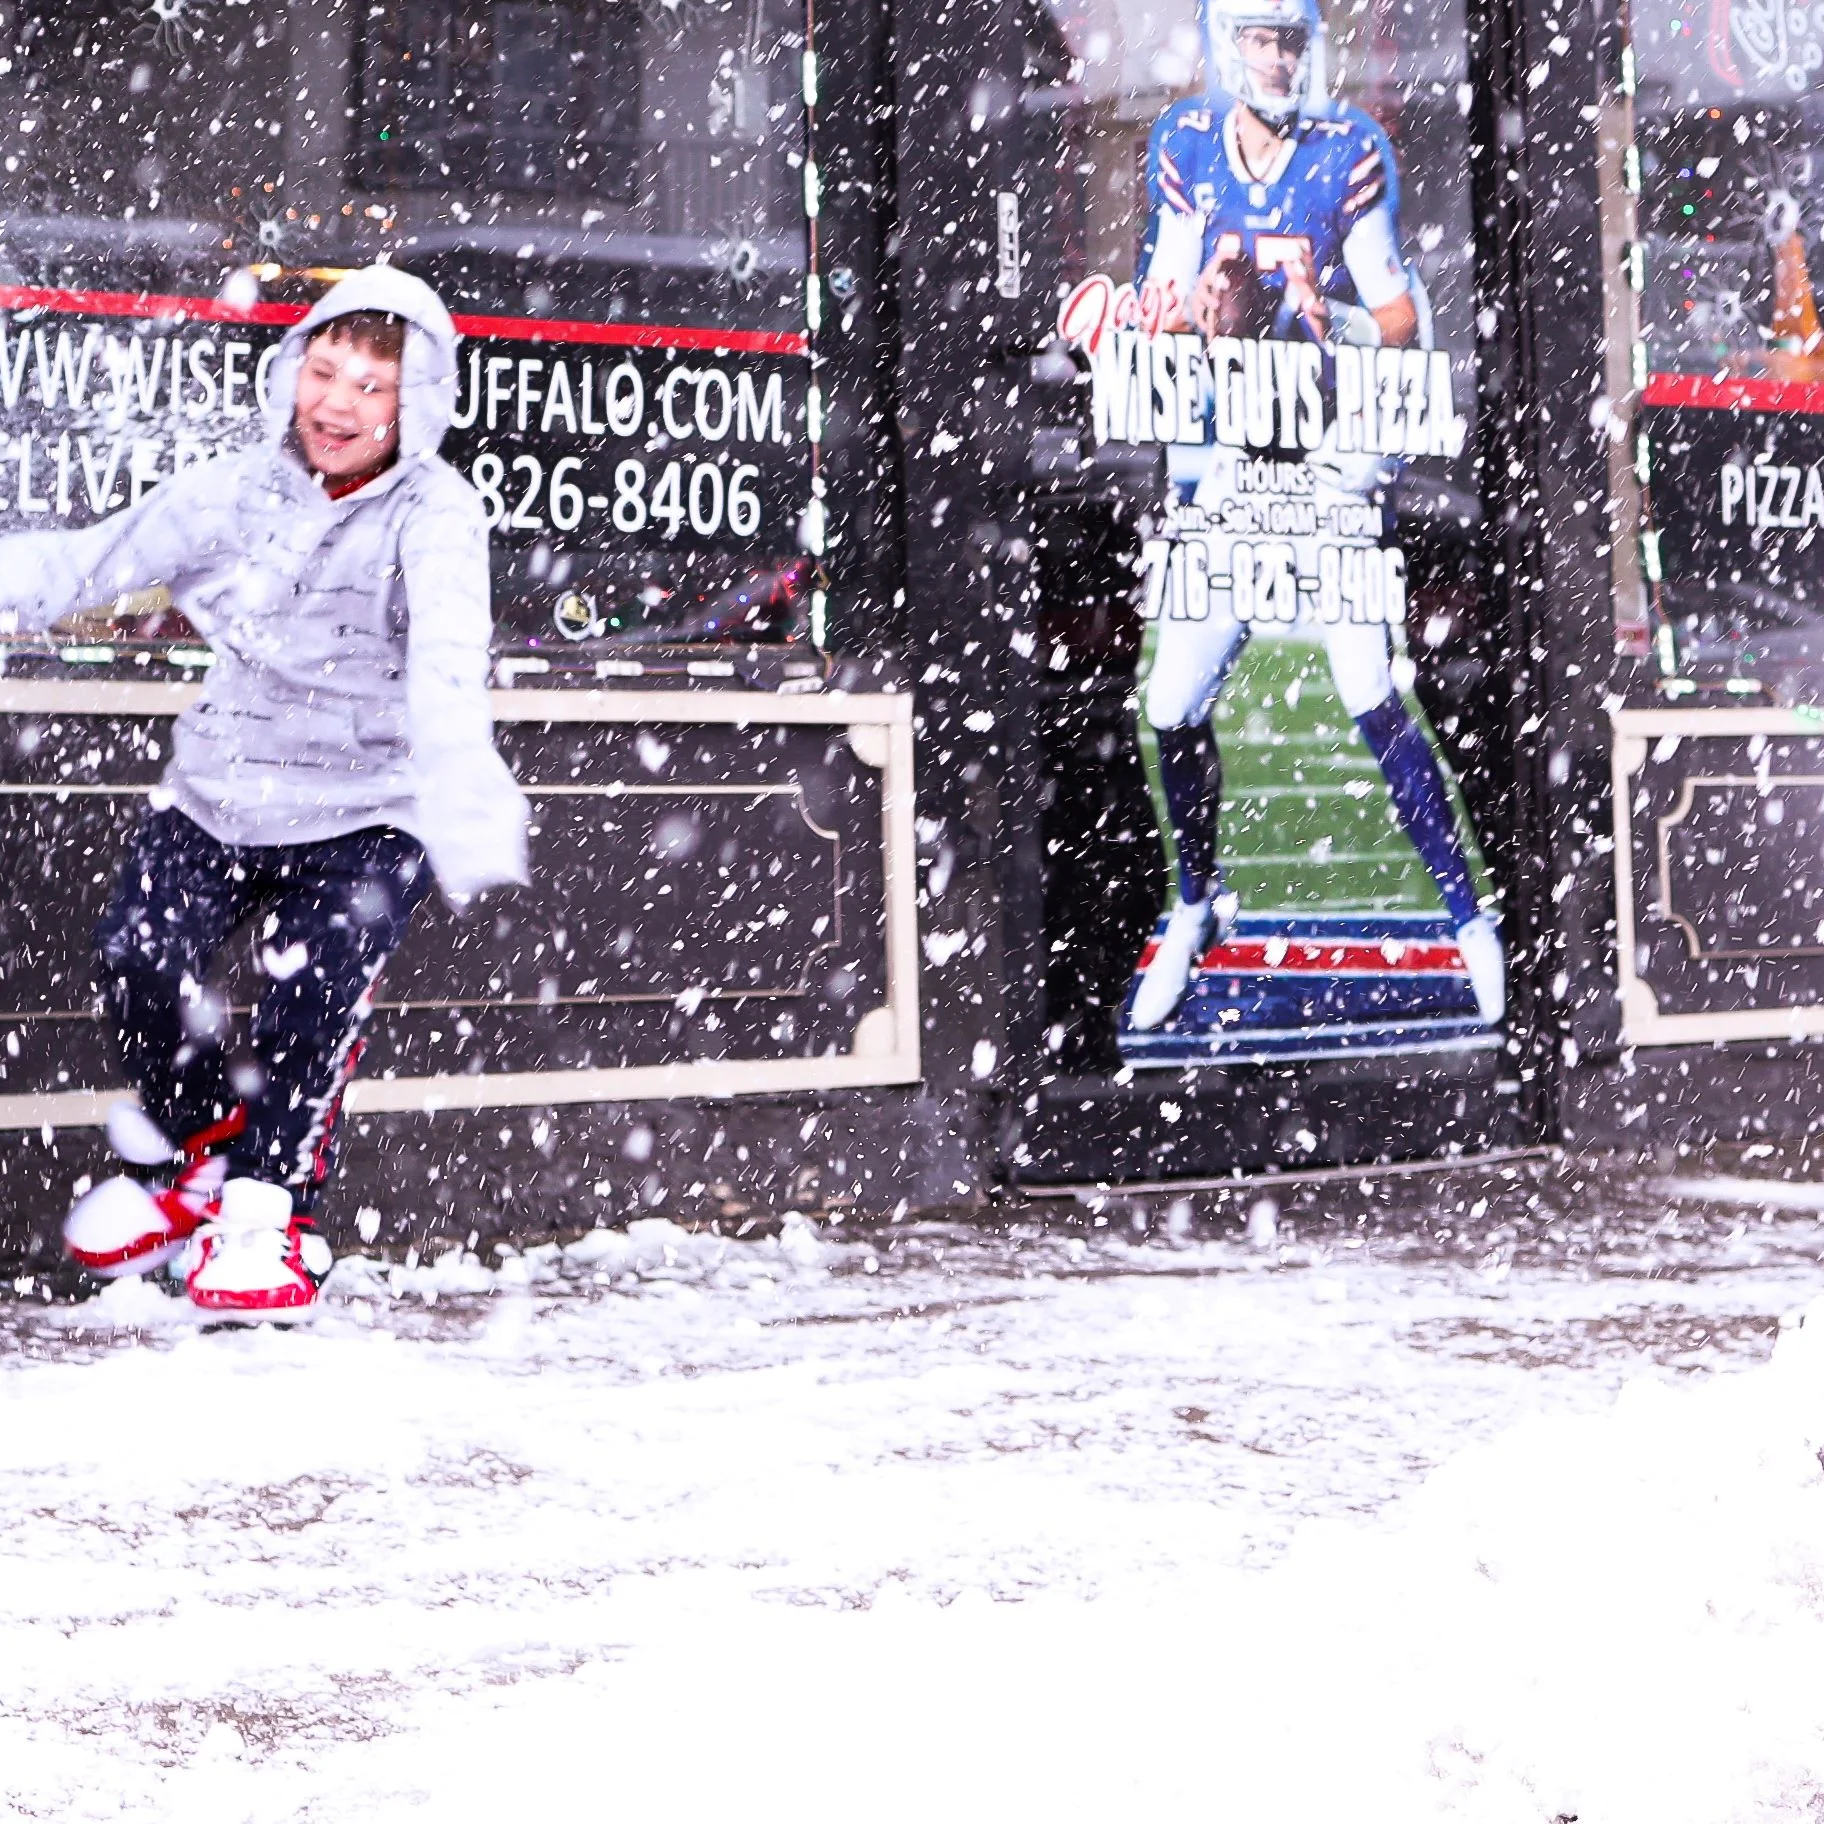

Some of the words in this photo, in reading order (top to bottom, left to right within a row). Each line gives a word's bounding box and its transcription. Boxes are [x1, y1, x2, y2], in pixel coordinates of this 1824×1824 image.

[1087, 331, 1206, 447] WISE
[1212, 337, 1324, 450] GUYS
[1334, 344, 1462, 457] PIZZA
[1237, 460, 1316, 496] HOURS:
[1141, 540, 1406, 625] 716-826-8406
